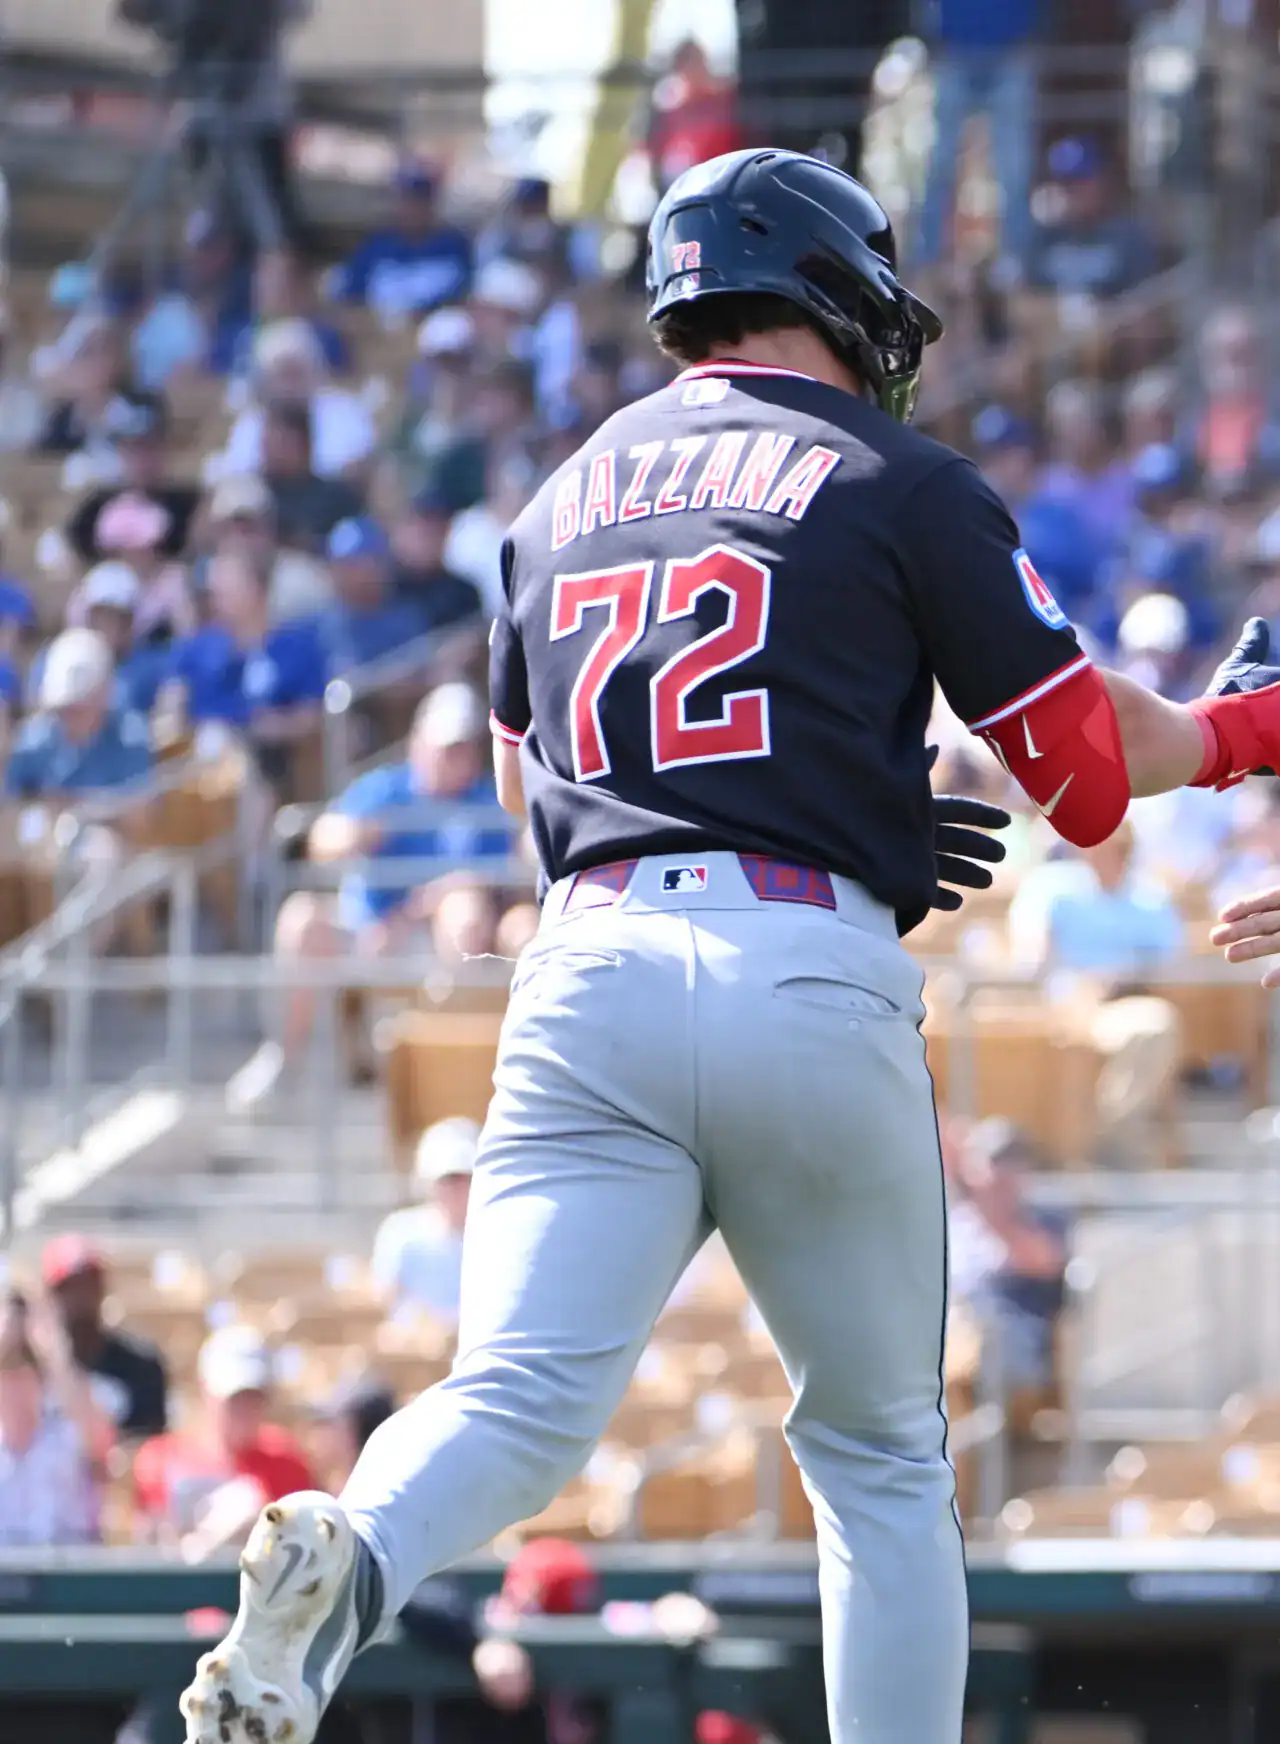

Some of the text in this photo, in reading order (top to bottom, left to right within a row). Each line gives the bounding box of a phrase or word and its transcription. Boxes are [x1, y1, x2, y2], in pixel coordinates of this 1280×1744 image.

[671, 241, 701, 272] 72
[551, 431, 842, 552] BAZZANA
[549, 543, 772, 783] 72
